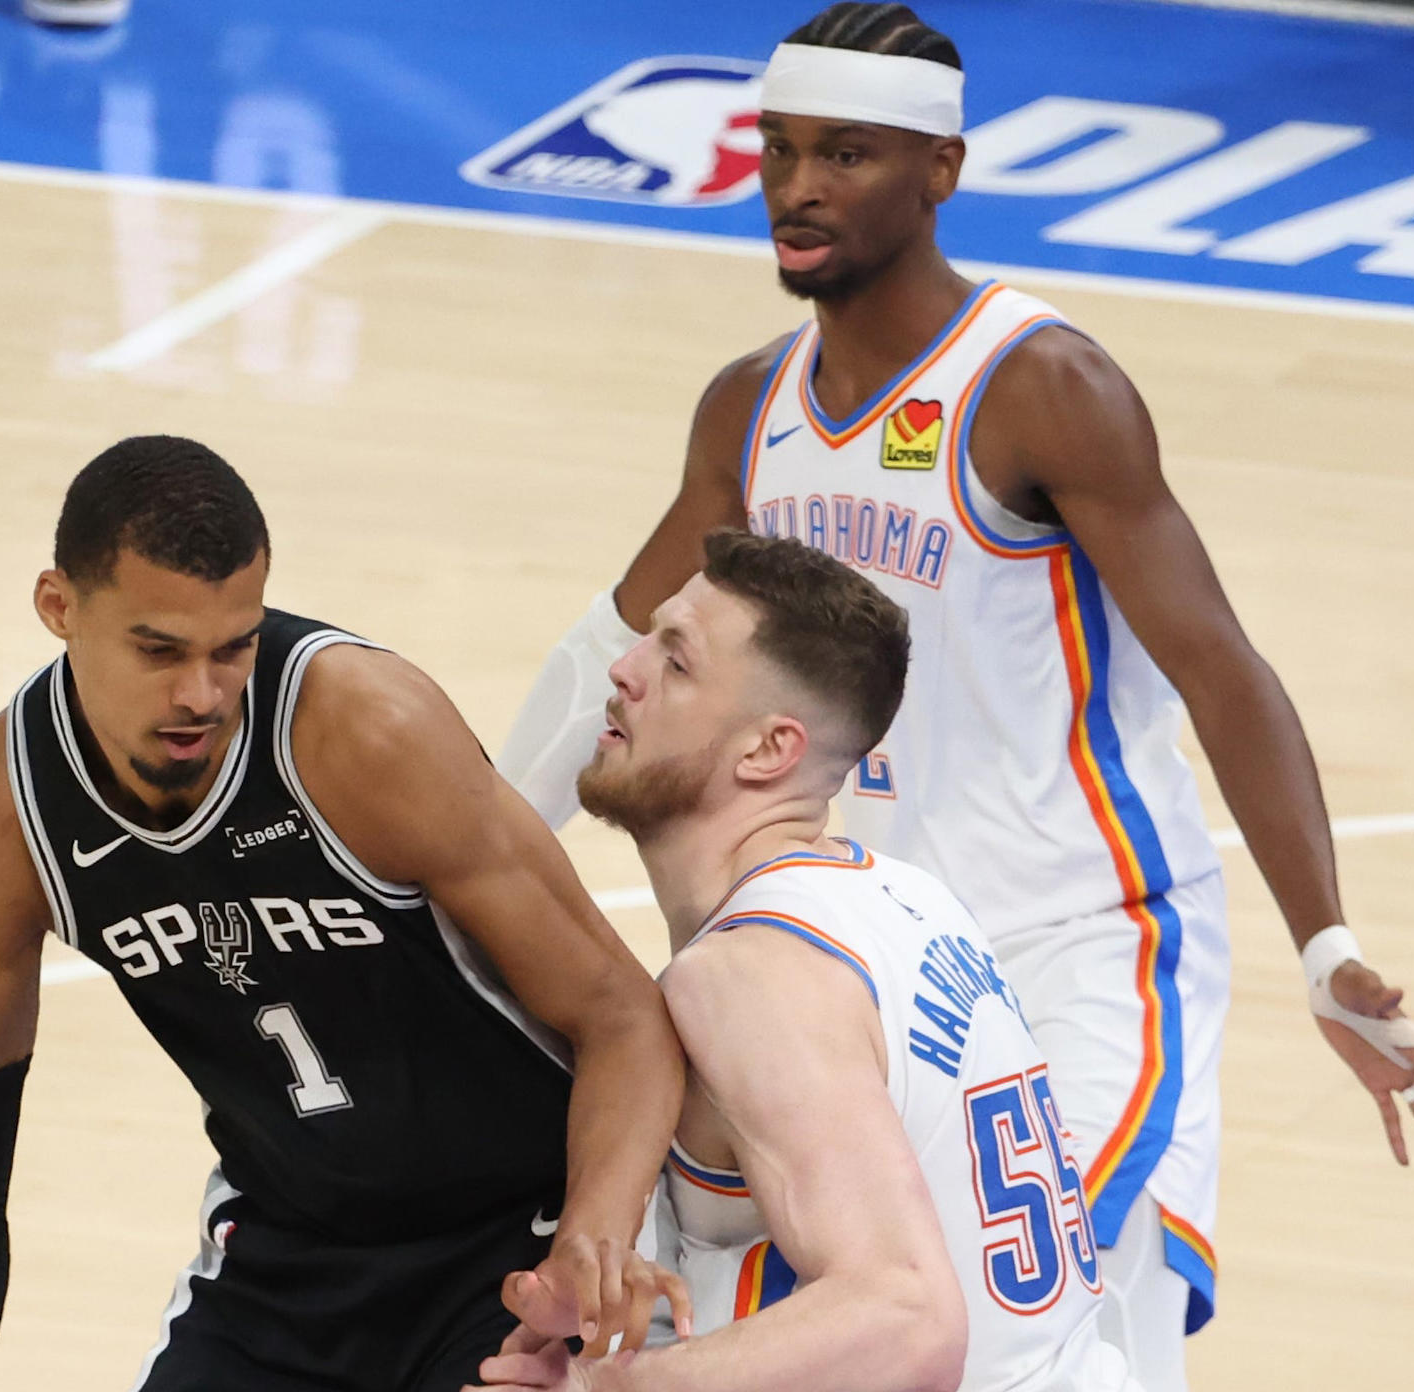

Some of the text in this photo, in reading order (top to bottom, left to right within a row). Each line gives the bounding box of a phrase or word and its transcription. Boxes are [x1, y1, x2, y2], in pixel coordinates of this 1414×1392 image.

[235, 820, 297, 849] LEDGER
[102, 896, 384, 994] SPURS
[253, 1002, 354, 1118] 1
[964, 1063, 1103, 1316] 55
